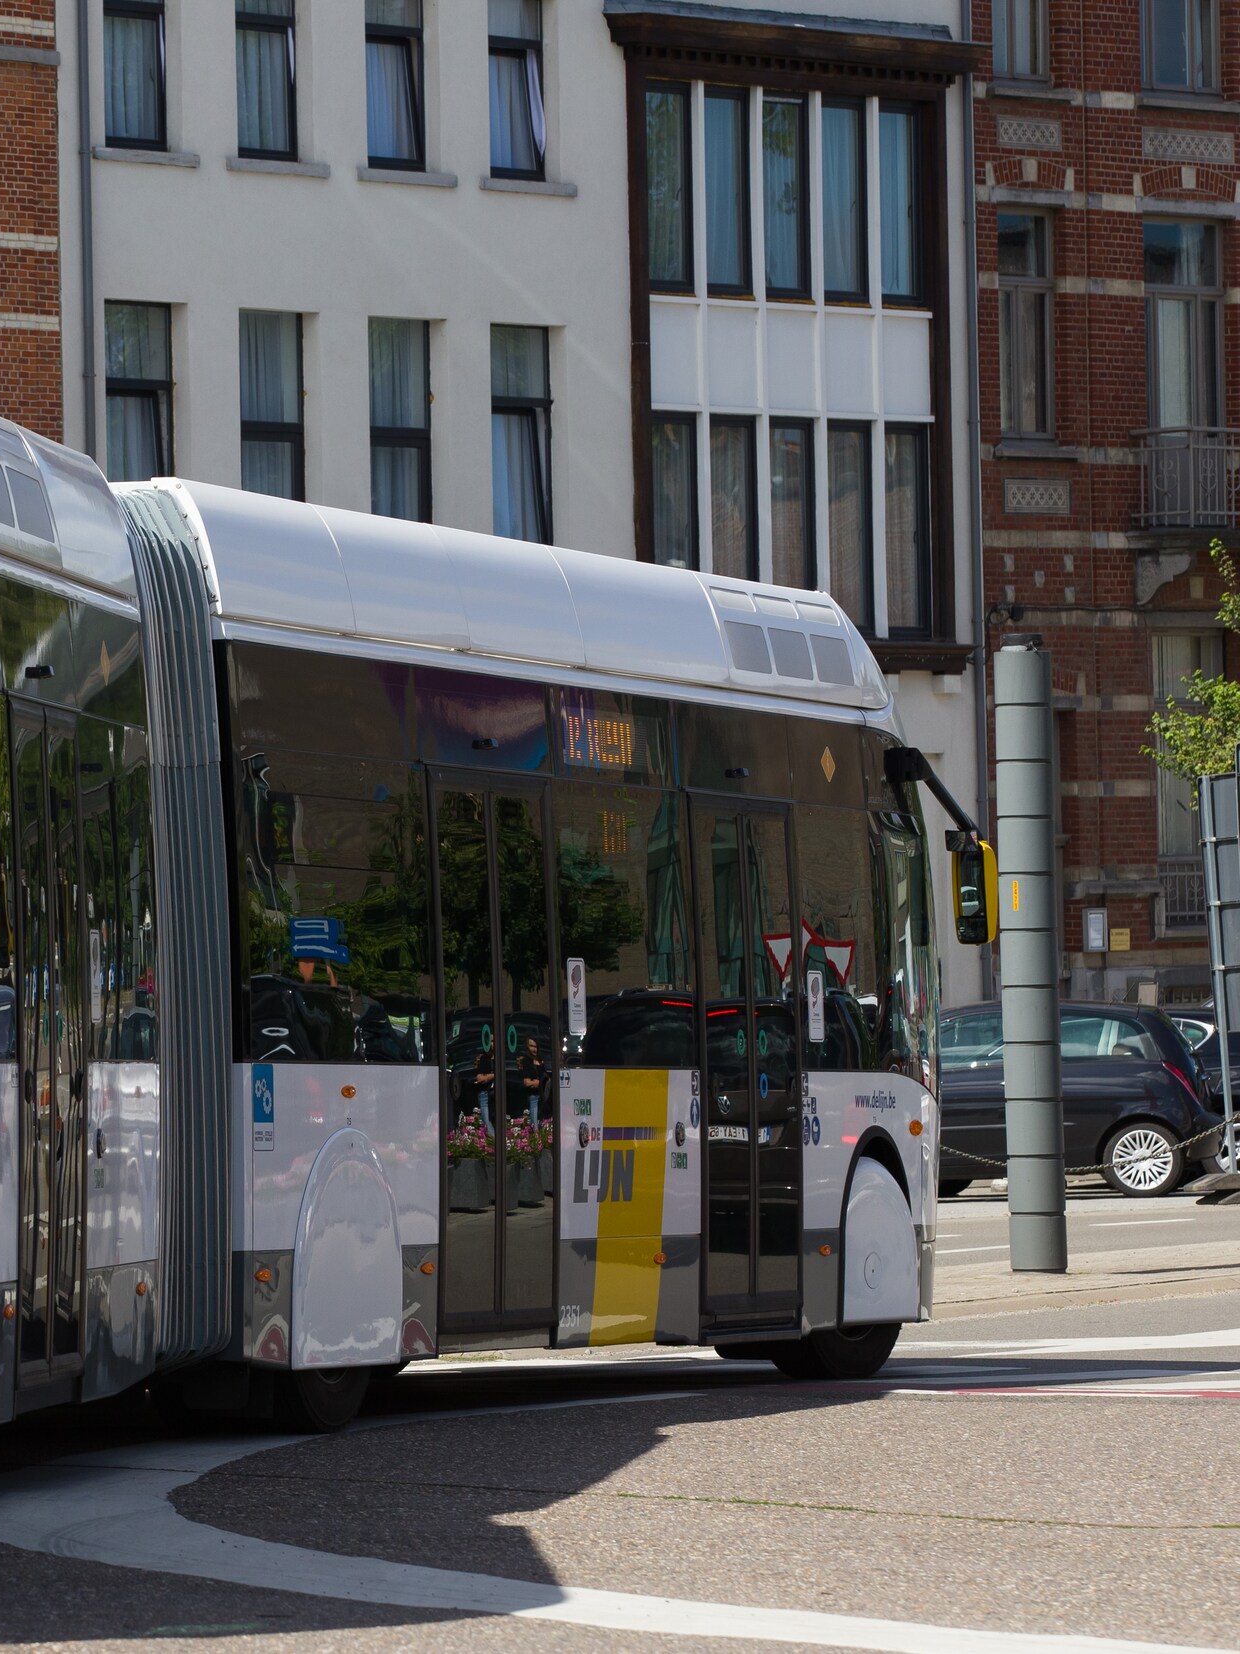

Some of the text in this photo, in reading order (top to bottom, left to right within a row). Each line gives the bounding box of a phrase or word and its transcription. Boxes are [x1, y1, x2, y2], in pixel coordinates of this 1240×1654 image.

[591, 1127, 601, 1142] DE
[572, 1149, 635, 1204] LIJN
[560, 1305, 580, 1328] 2351
